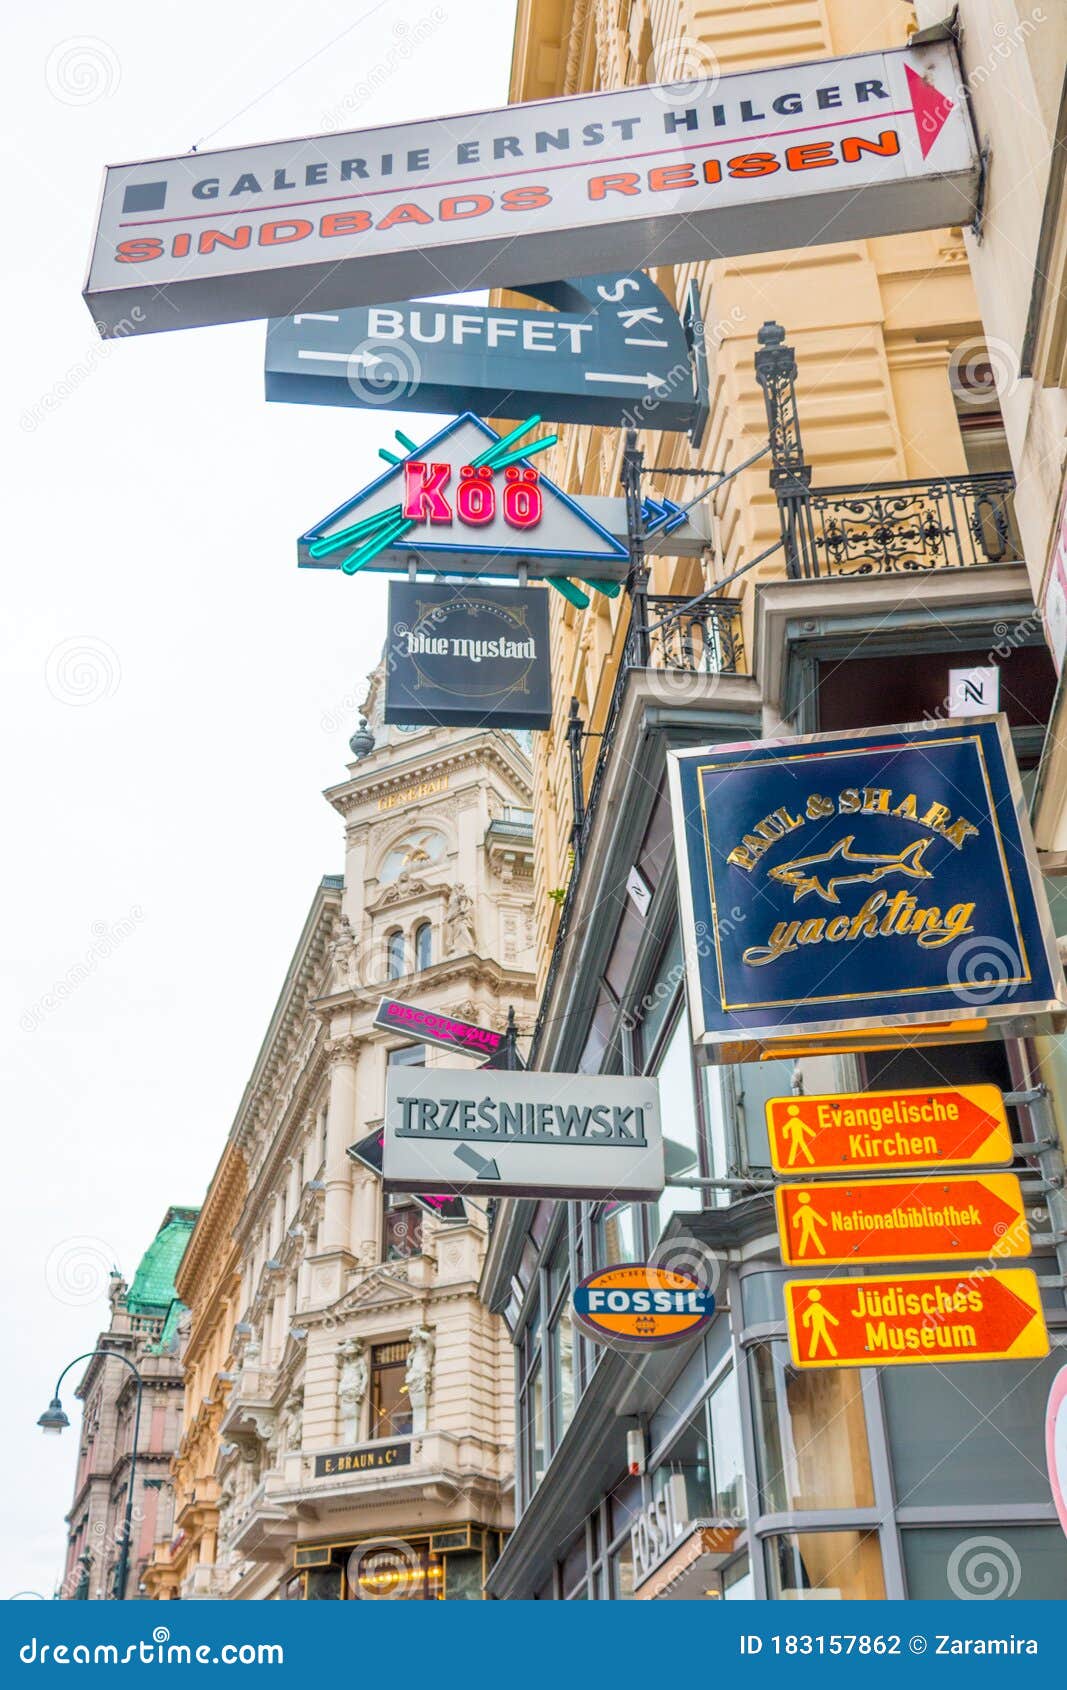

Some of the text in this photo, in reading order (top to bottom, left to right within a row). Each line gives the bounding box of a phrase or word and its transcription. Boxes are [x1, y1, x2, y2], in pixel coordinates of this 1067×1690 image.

[192, 80, 890, 200] GALERIE ERNST HILGER
[114, 130, 900, 263] SINDBADS REISEN
[366, 308, 593, 355] BUFFET
[400, 631, 537, 663] blue mustard
[726, 787, 980, 873] PAUL & SHARK
[742, 890, 977, 967] yachting
[387, 1002, 501, 1048] DISCOTHEQUE
[396, 1095, 647, 1142] TRZEŚNIEWSKI
[816, 1099, 960, 1131] Evangelische
[848, 1134, 938, 1159] Kirchen
[830, 1205, 983, 1232] Nationalbibliothek
[588, 1290, 705, 1313] FOSSIL
[851, 1286, 984, 1319] Jüdisches
[865, 1321, 977, 1351] Museum
[338, 1453, 374, 1471] BRAUN
[630, 1473, 688, 1592] FOSSIL
